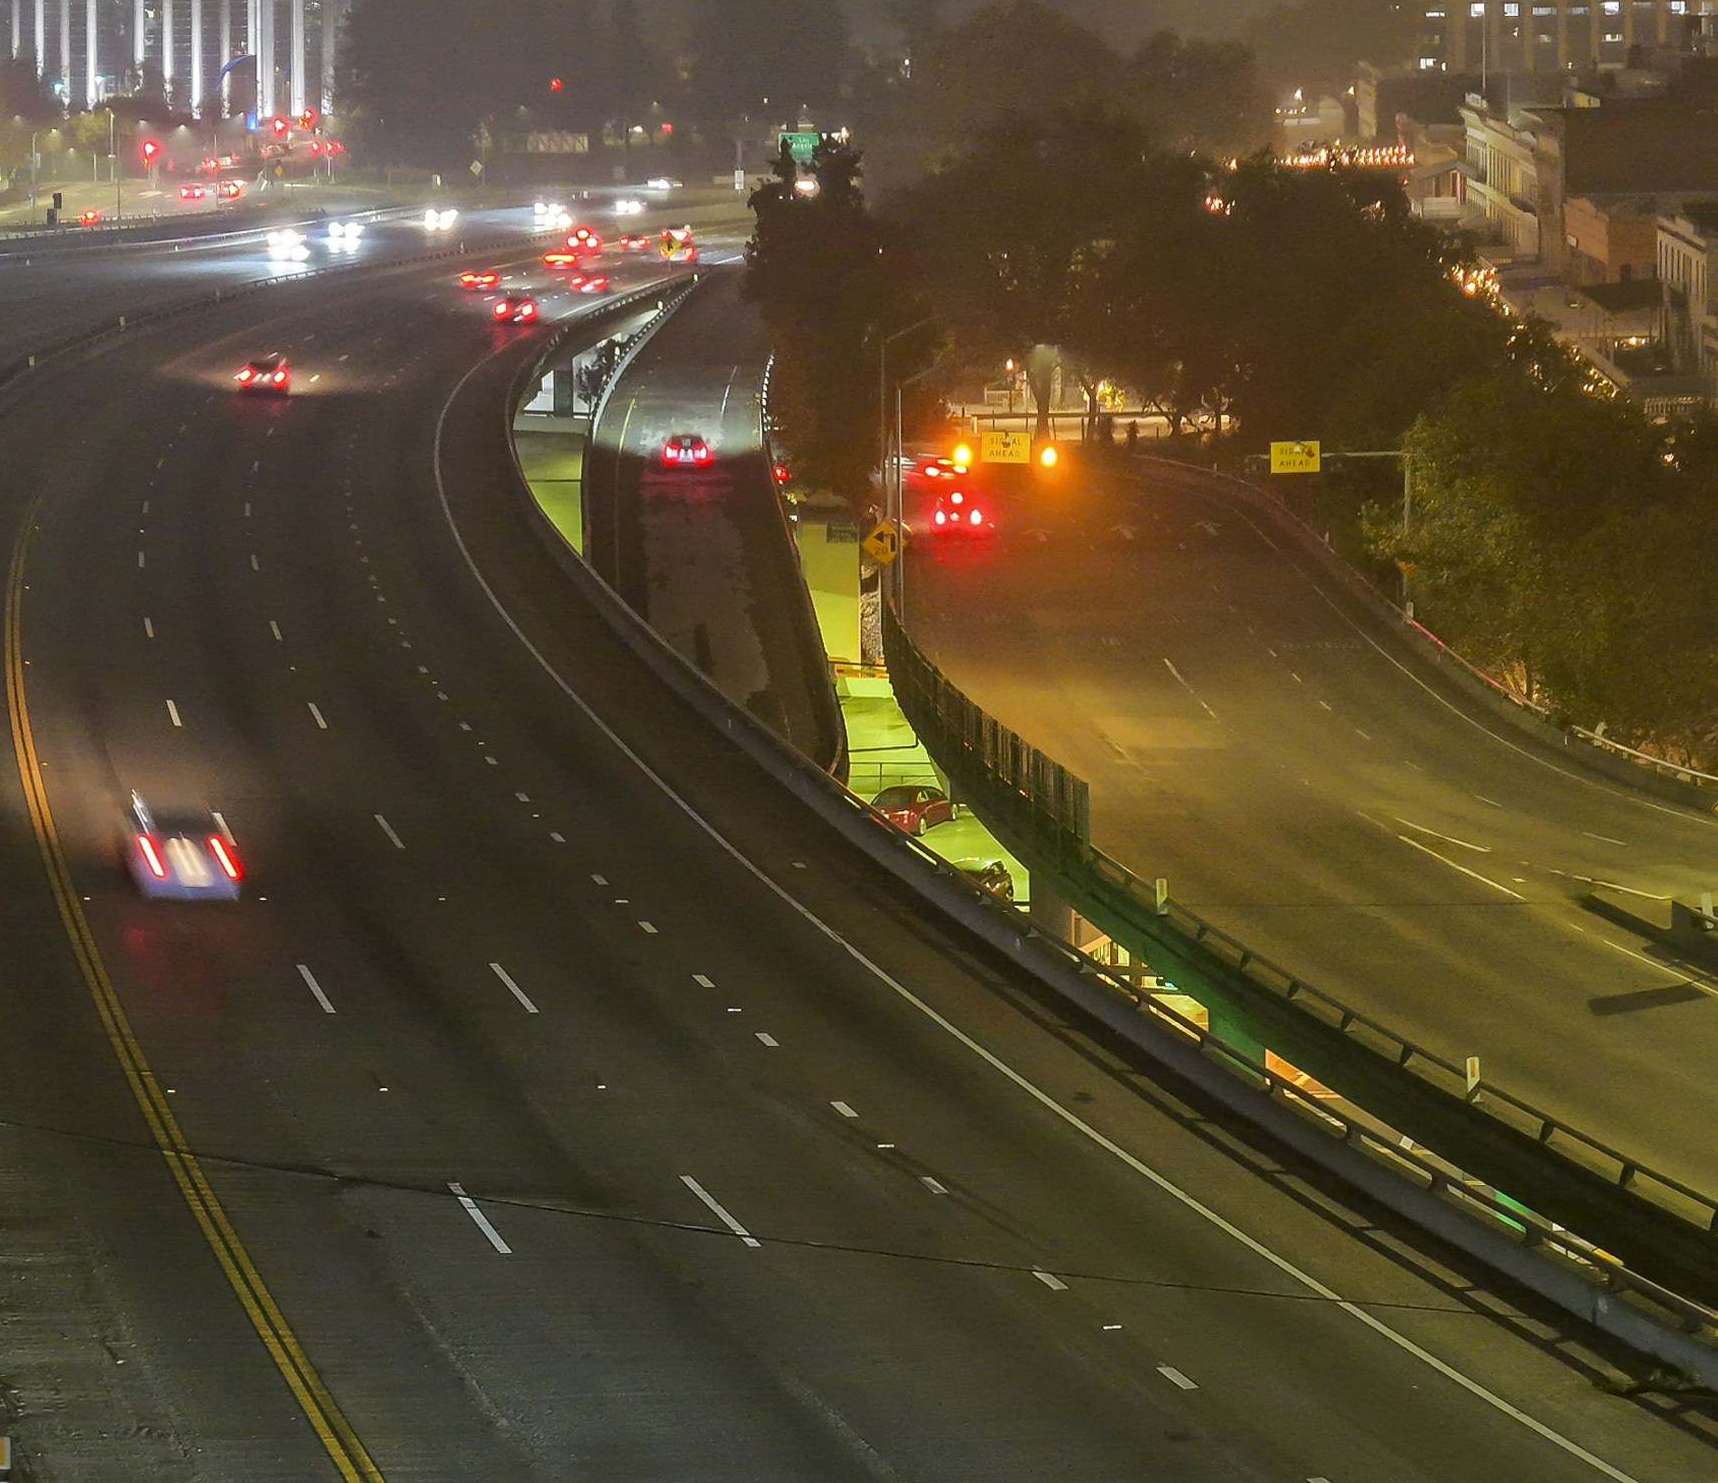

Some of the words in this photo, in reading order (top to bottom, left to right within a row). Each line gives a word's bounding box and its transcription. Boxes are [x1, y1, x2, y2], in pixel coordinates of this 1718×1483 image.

[990, 449, 1021, 458] AHEAD
[1279, 459, 1311, 467] AHEAD
[874, 546, 889, 556] 20
